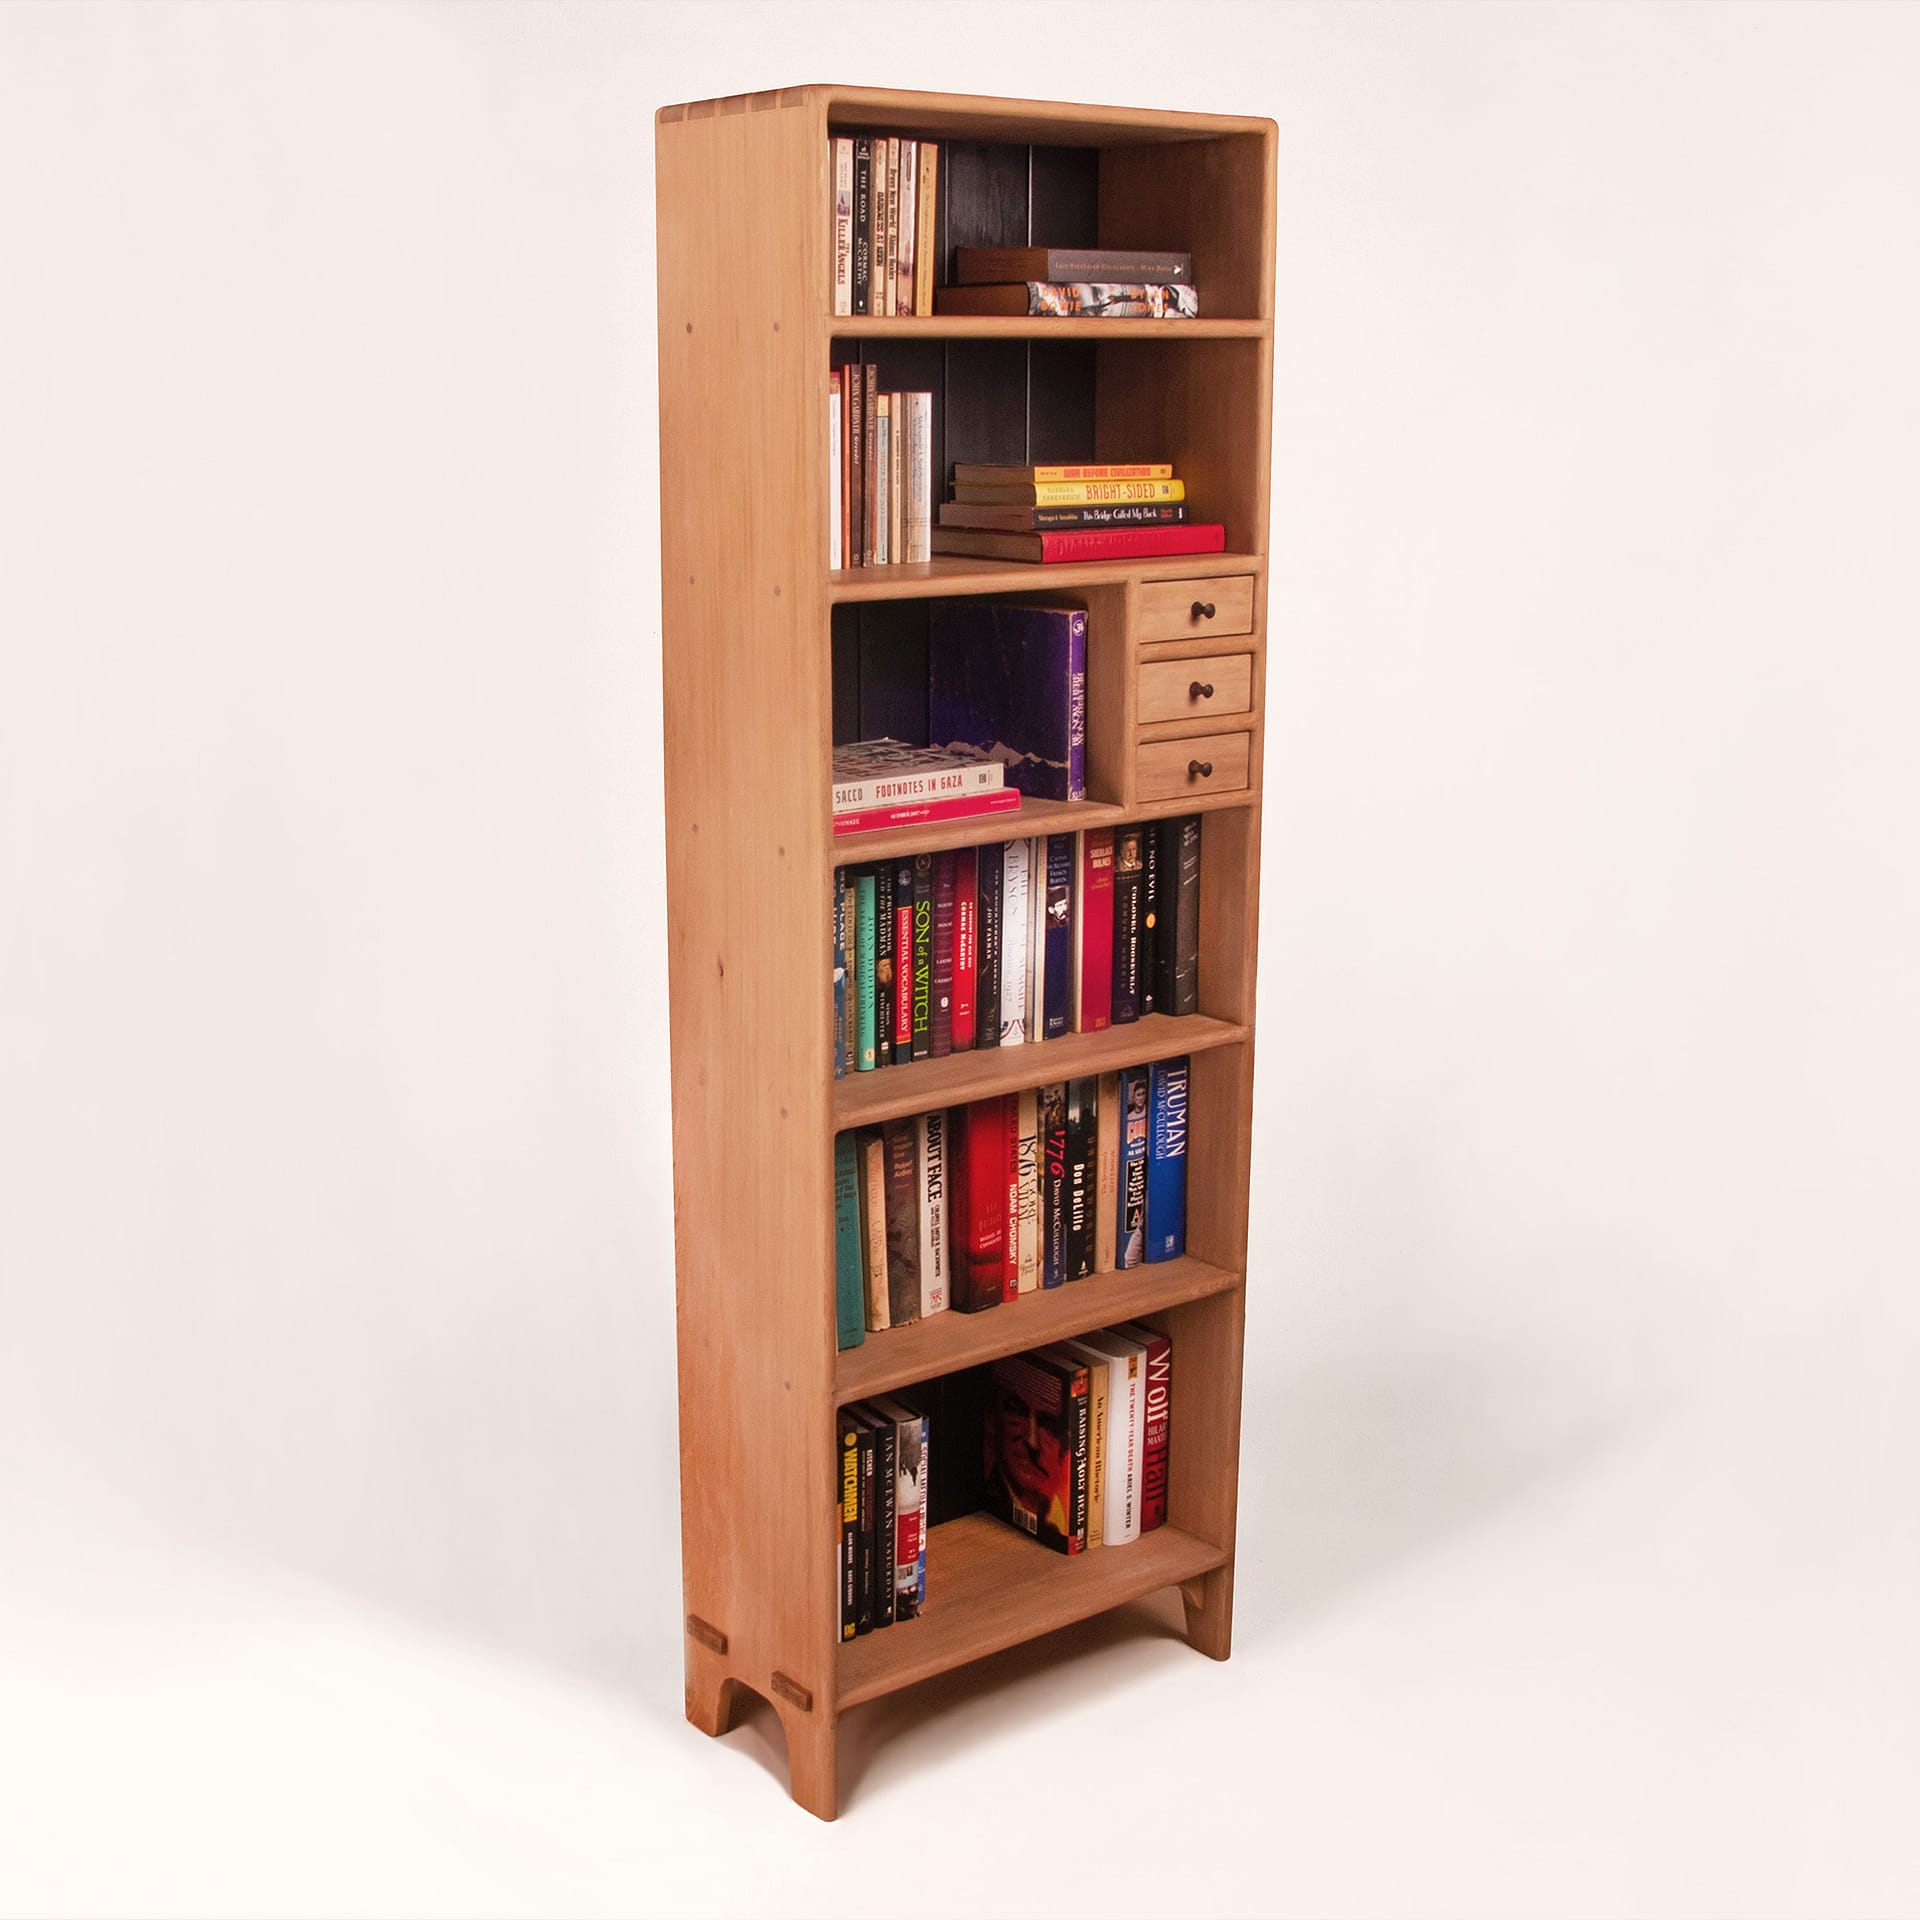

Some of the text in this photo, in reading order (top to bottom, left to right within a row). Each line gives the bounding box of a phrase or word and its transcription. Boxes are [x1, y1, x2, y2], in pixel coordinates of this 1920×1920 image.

[860, 170, 868, 189] THE
[889, 168, 897, 189] Brave
[837, 218, 848, 285] KILLER ANGELS
[1040, 300, 1082, 312] BOWIE
[1041, 287, 1081, 298] DAVID
[1130, 288, 1169, 300] DYLAN
[1131, 303, 1169, 314] JONES
[852, 397, 860, 434] GARDNER
[1083, 468, 1108, 478] BEFORE
[1086, 483, 1156, 500] BRIGHT-SIDED
[1094, 509, 1112, 521] Bridge
[1113, 508, 1131, 519] Called
[1132, 508, 1142, 520] My
[1142, 507, 1157, 518] Back
[836, 788, 863, 804] SACCO
[875, 775, 963, 799] FOOTNOTES IN GAZA
[1148, 850, 1155, 869] NO
[1147, 873, 1155, 903] EVIL
[915, 900, 930, 944] SON
[900, 909, 909, 1032] ESSENTIAL VOCABULARY
[916, 946, 927, 958] of
[1129, 936, 1137, 995] ROOSEVELT
[914, 964, 928, 1033] WITCH
[1155, 1070, 1167, 1160] DAVID McCULLOUGH
[1166, 1065, 1188, 1158] TRUMAN
[927, 1114, 943, 1203] ABOUT FACE
[1010, 1137, 1018, 1174] STATES
[1019, 1135, 1037, 1177] 1876
[1072, 1163, 1085, 1231] Don DeLillo
[1009, 1184, 1017, 1265] NOAM CHOMSKY
[1053, 1179, 1061, 1266] DAVID McCULLOUGH
[1147, 1348, 1170, 1423] Wolf
[885, 1435, 894, 1462] IAN
[1075, 1408, 1087, 1458] RAISING
[1094, 1395, 1105, 1504] An American Rhetoric
[843, 1448, 858, 1523] WATCHMEN
[1076, 1458, 1087, 1491] HOLY
[1145, 1445, 1167, 1503] Hall
[885, 1468, 894, 1529] McEWAN
[1076, 1494, 1085, 1525] HELL
